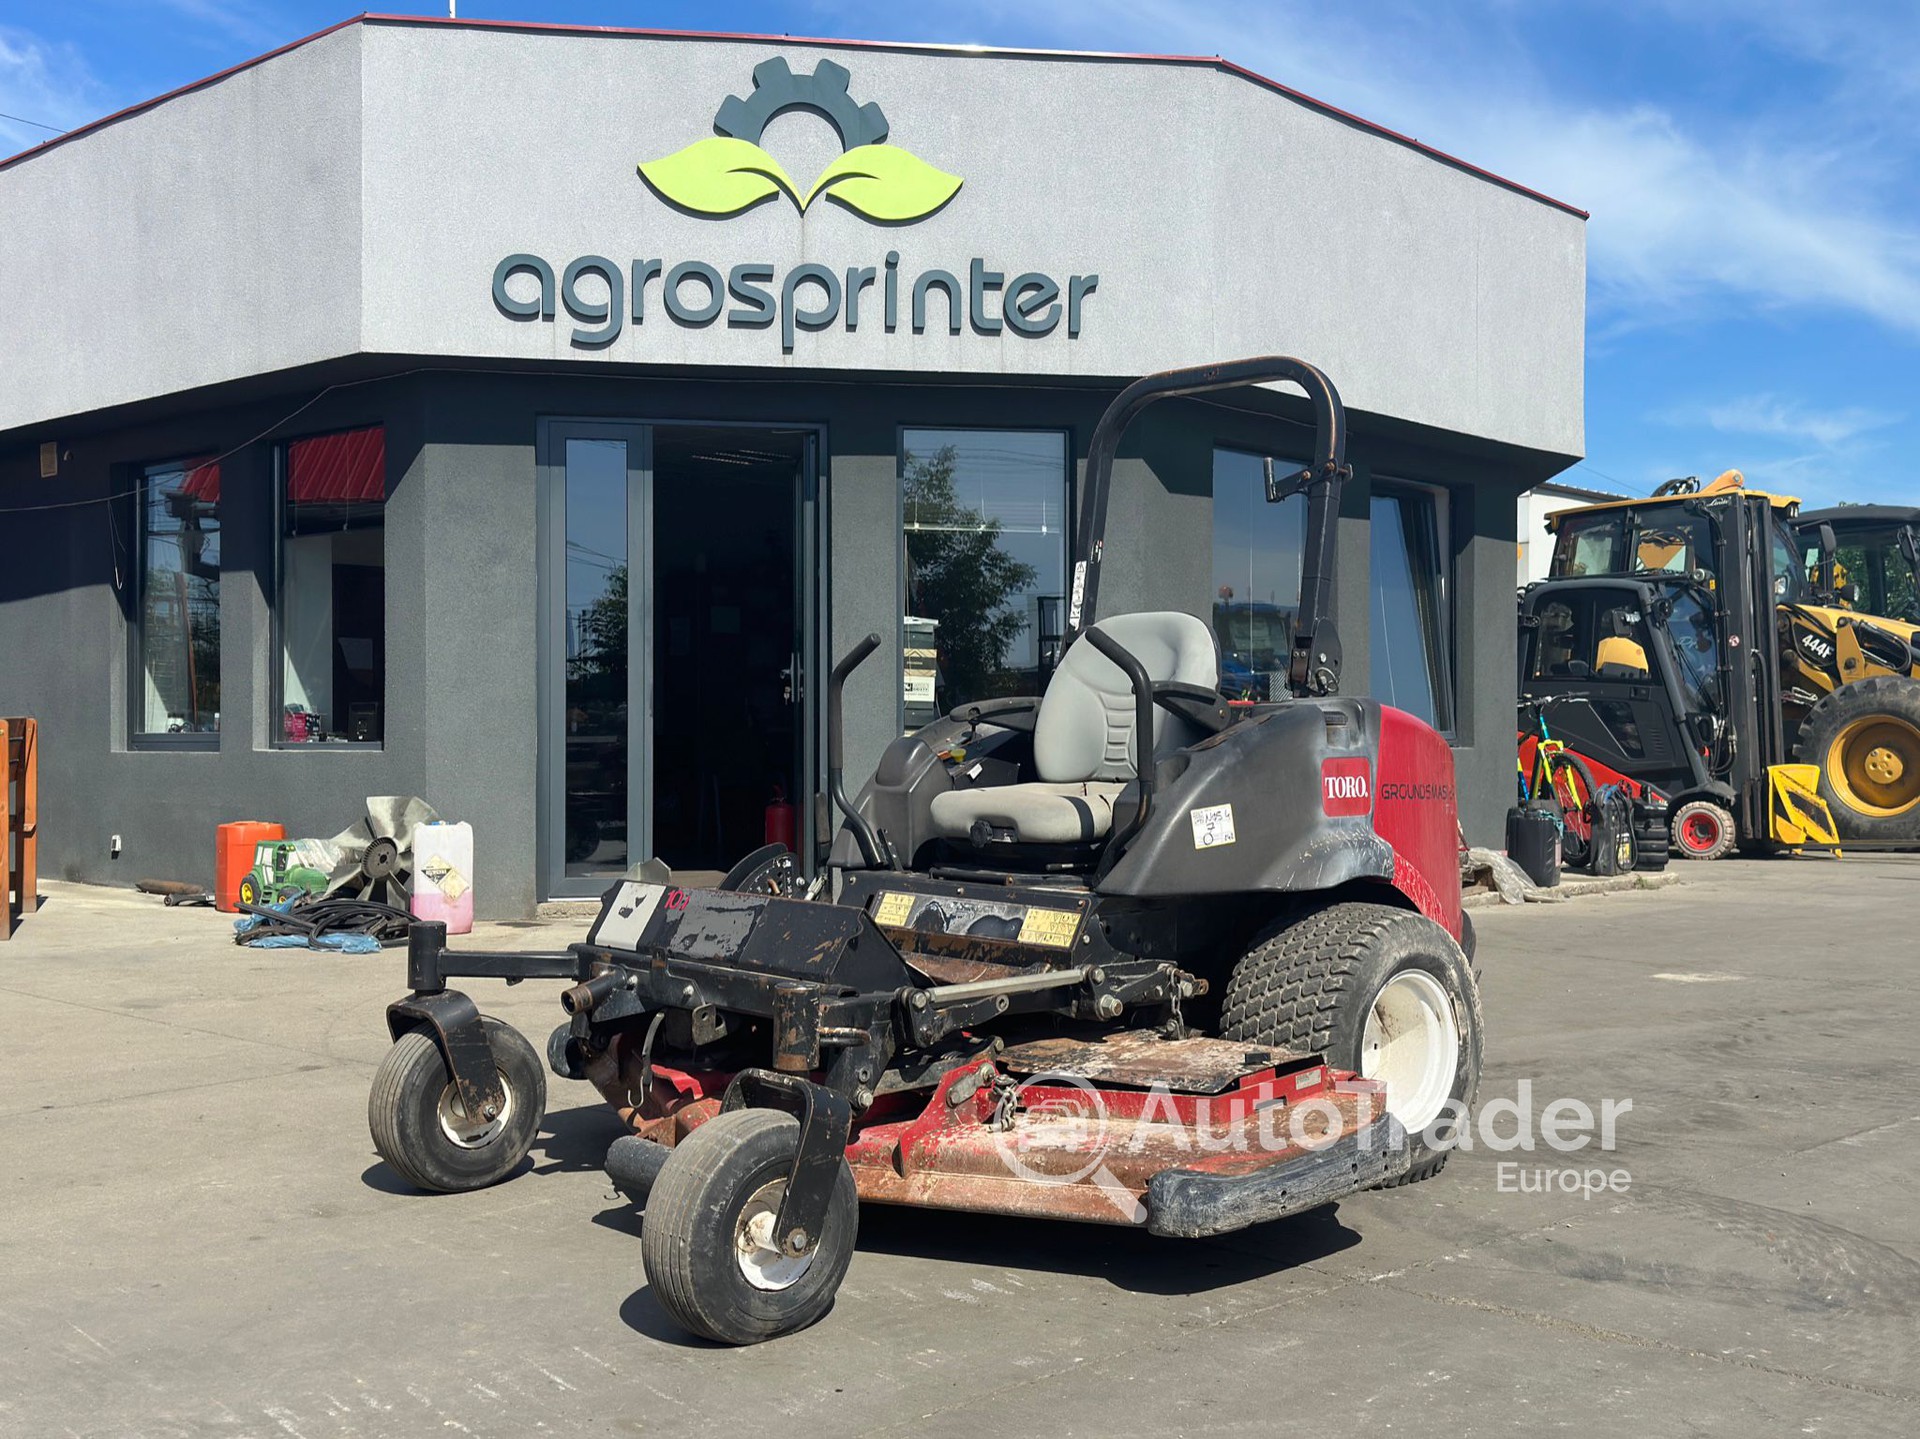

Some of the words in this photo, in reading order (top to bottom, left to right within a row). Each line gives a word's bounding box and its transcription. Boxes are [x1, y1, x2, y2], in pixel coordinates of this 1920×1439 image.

[492, 251, 1099, 354] agrosprinter
[1801, 634, 1835, 659] 444F
[1381, 783, 1455, 800] GROUNDSMAS
